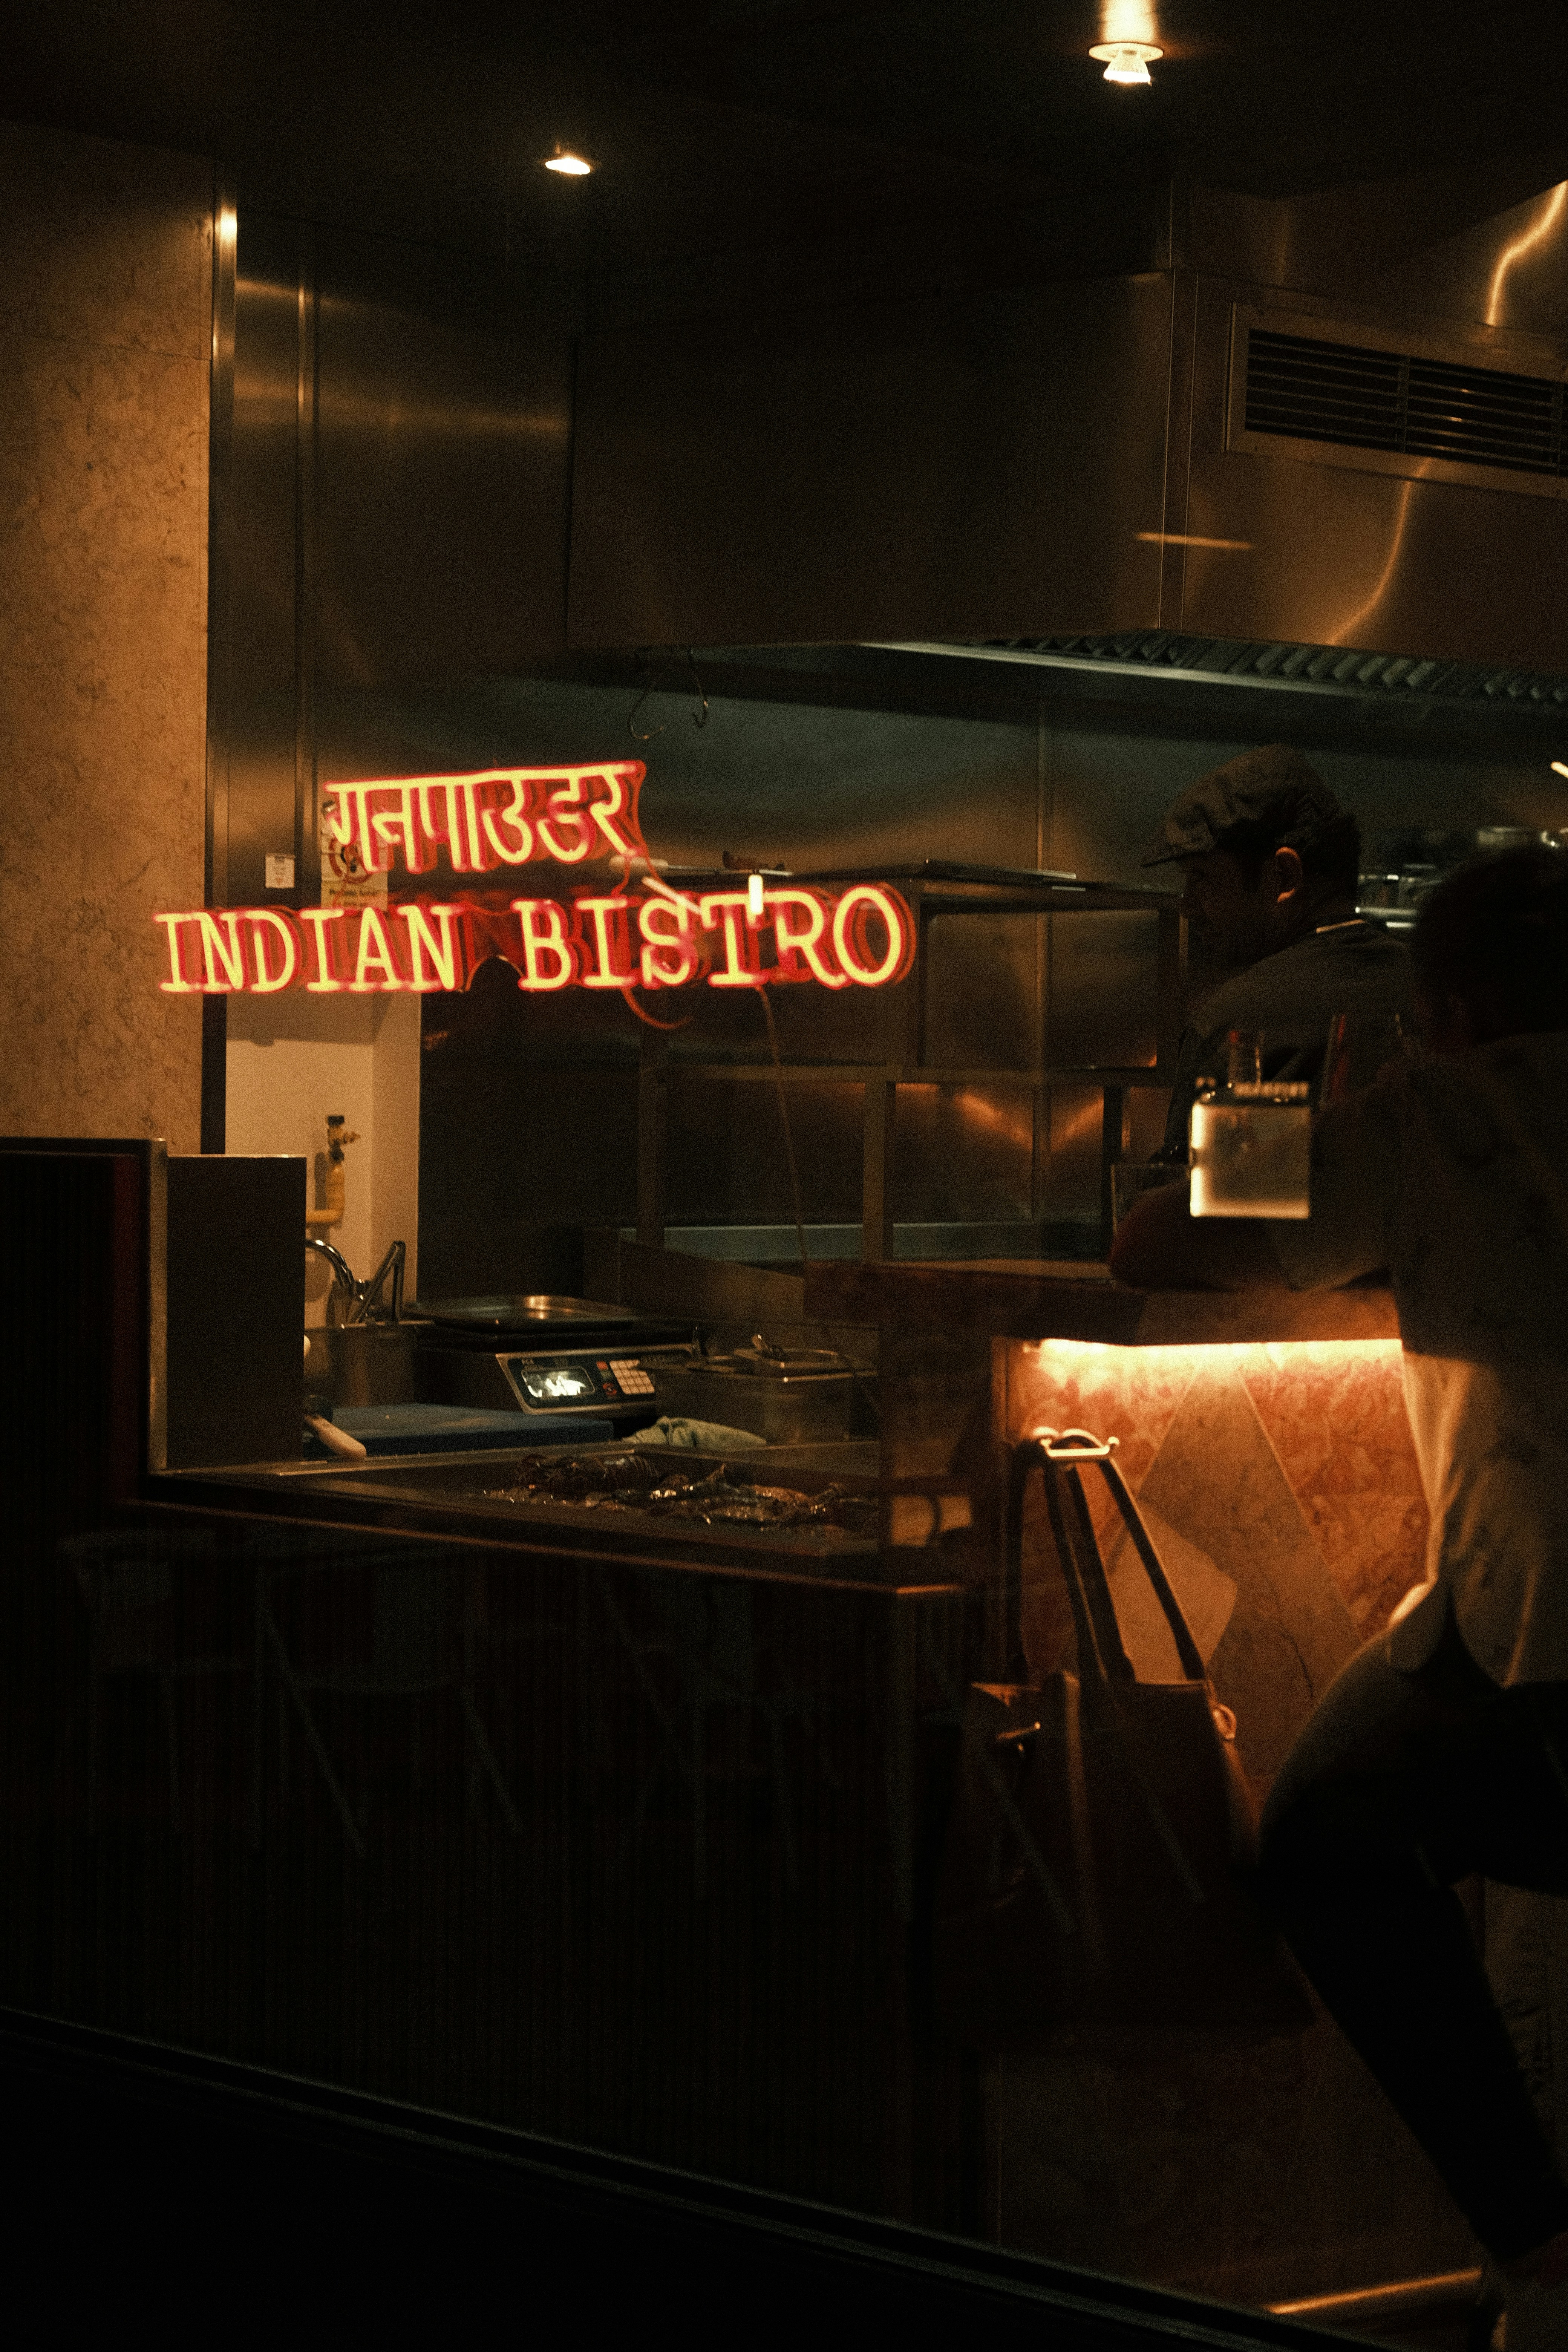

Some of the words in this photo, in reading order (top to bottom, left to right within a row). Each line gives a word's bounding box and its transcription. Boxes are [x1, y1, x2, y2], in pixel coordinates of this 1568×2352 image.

[324, 761, 639, 874] गनपाउडर
[153, 905, 467, 993] INDIAN
[511, 885, 908, 990] BISTRO
